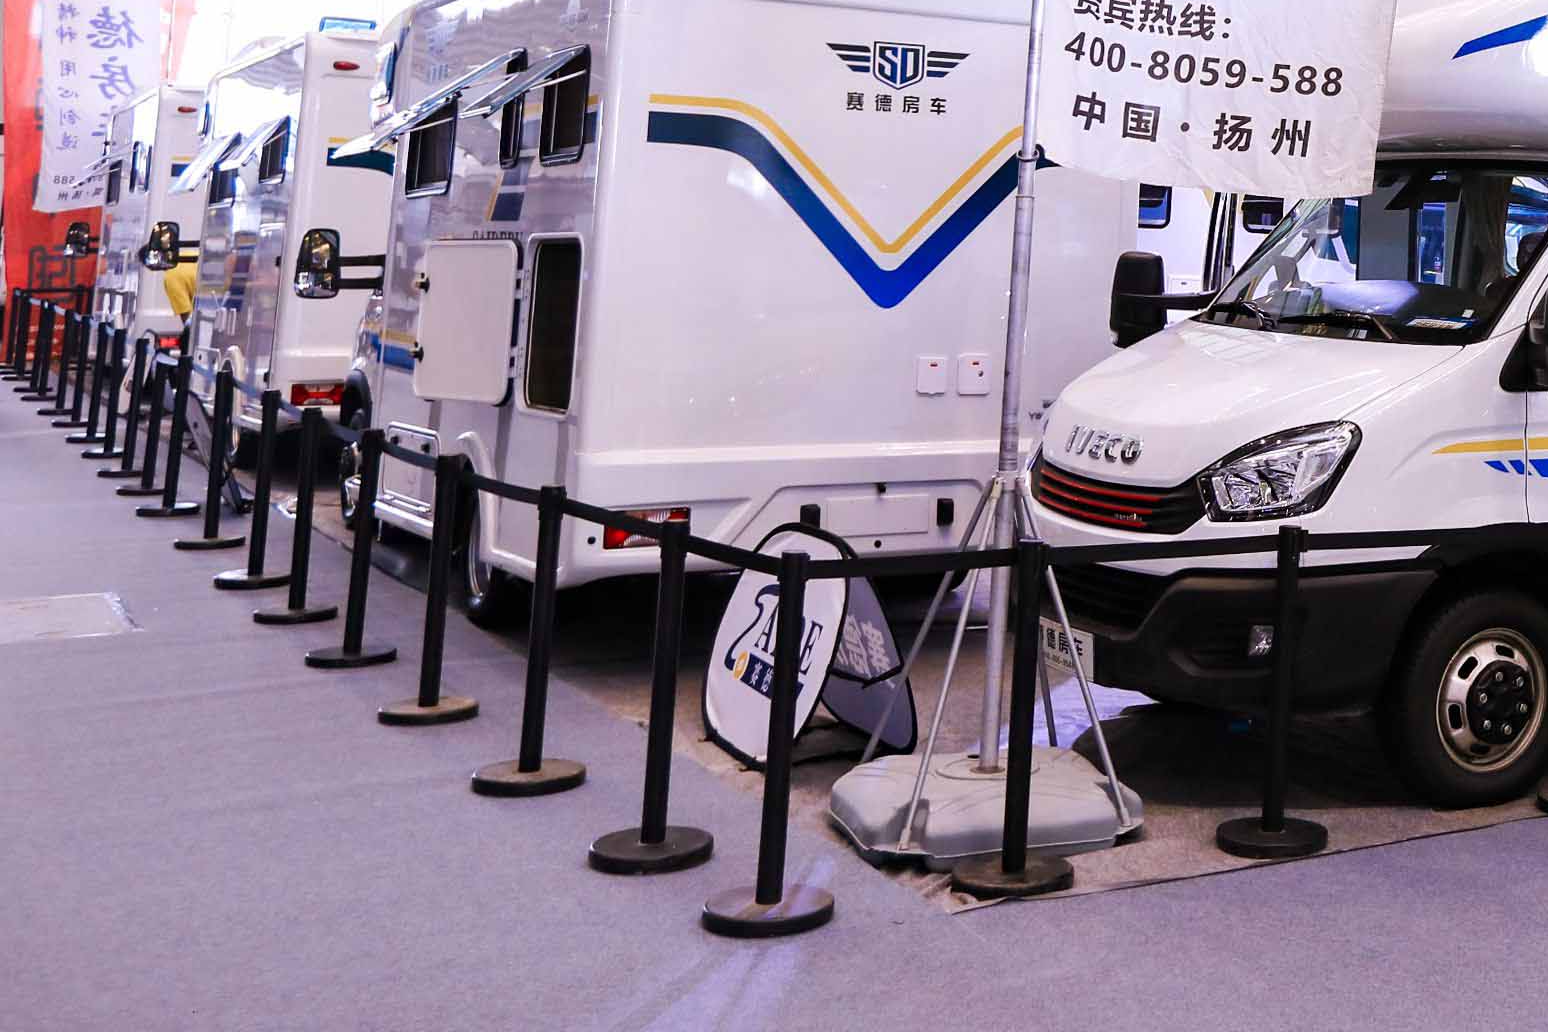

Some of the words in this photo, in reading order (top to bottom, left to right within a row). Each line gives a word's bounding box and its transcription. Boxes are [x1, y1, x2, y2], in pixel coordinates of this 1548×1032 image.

[1063, 30, 1344, 97] 400-8059-588
[846, 91, 947, 116] 赛德房车
[1064, 423, 1144, 465] IVECO
